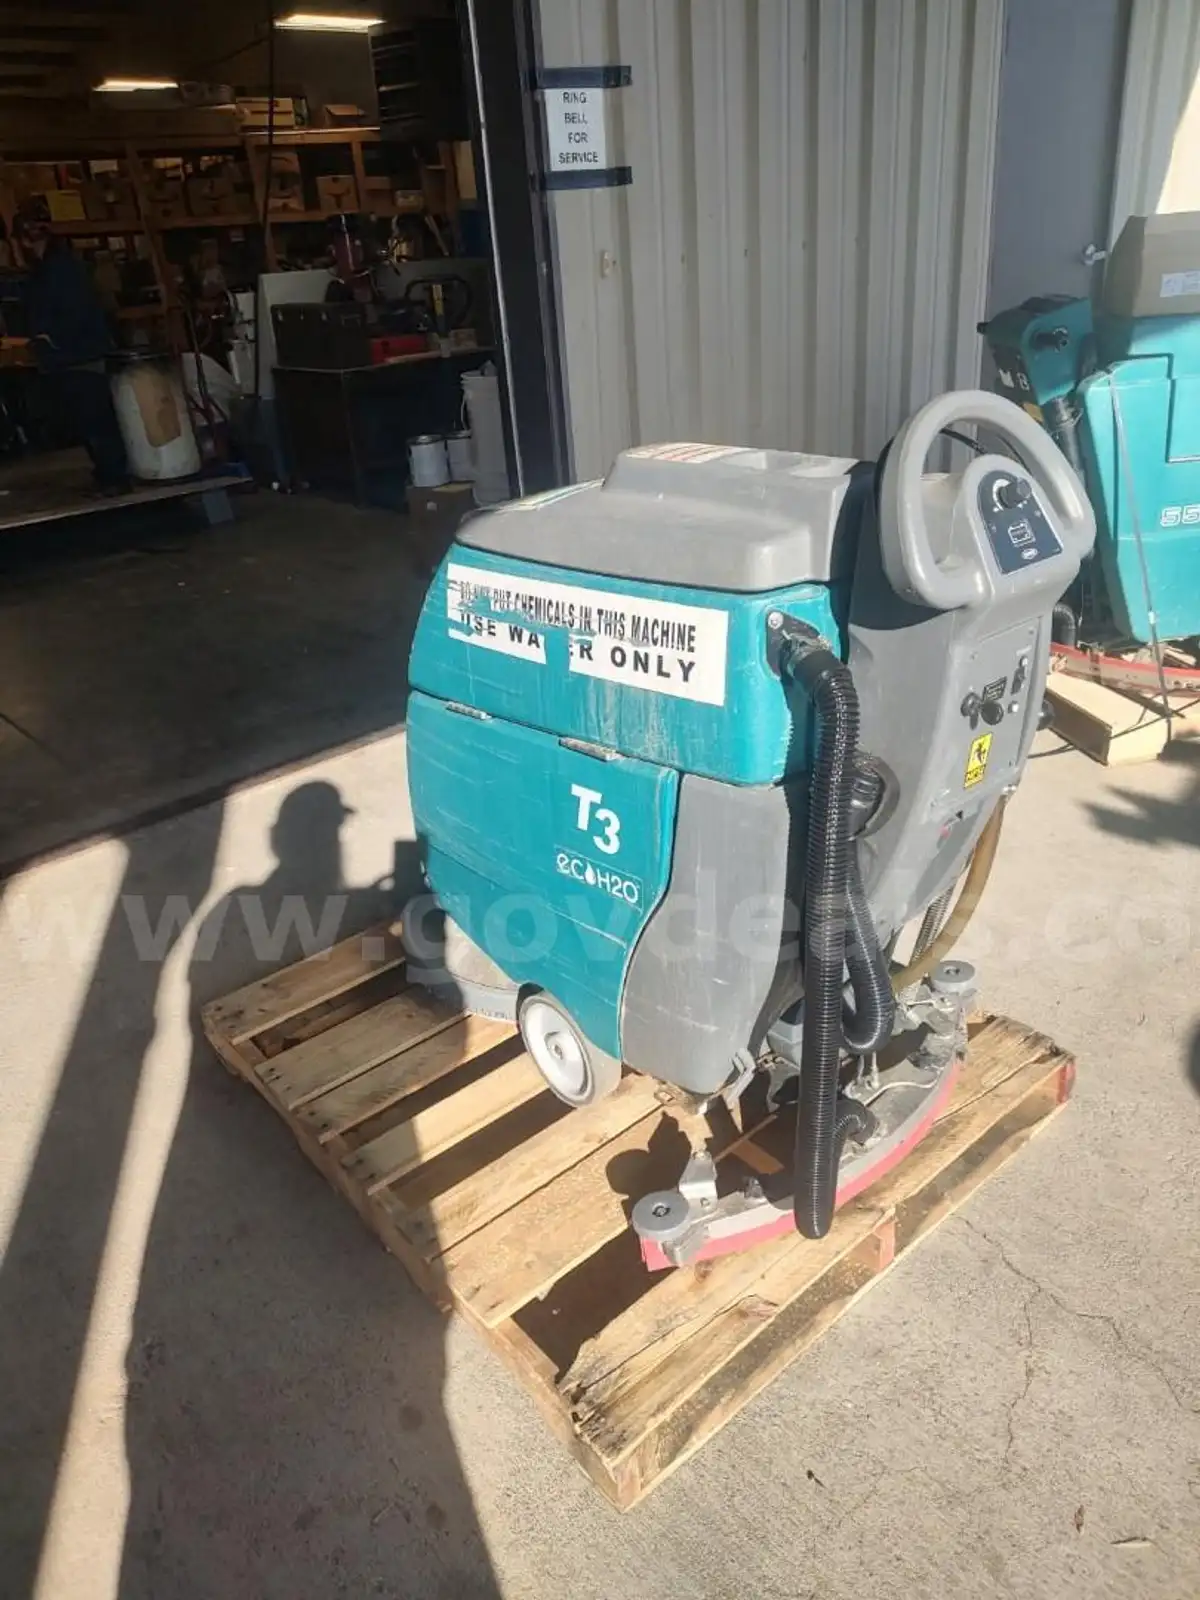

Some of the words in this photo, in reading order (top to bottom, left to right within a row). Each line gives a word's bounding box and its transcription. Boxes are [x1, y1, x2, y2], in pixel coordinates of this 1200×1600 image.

[562, 91, 587, 104] RING
[564, 112, 588, 124] BELL
[567, 132, 589, 144] FOR
[558, 151, 599, 164] SERVICE
[514, 592, 576, 629] CHEMICALS
[579, 604, 593, 632] IN
[596, 608, 626, 641] THIS
[631, 614, 697, 653] MACHINE
[610, 645, 696, 683] ONLY
[571, 783, 621, 855] T3
